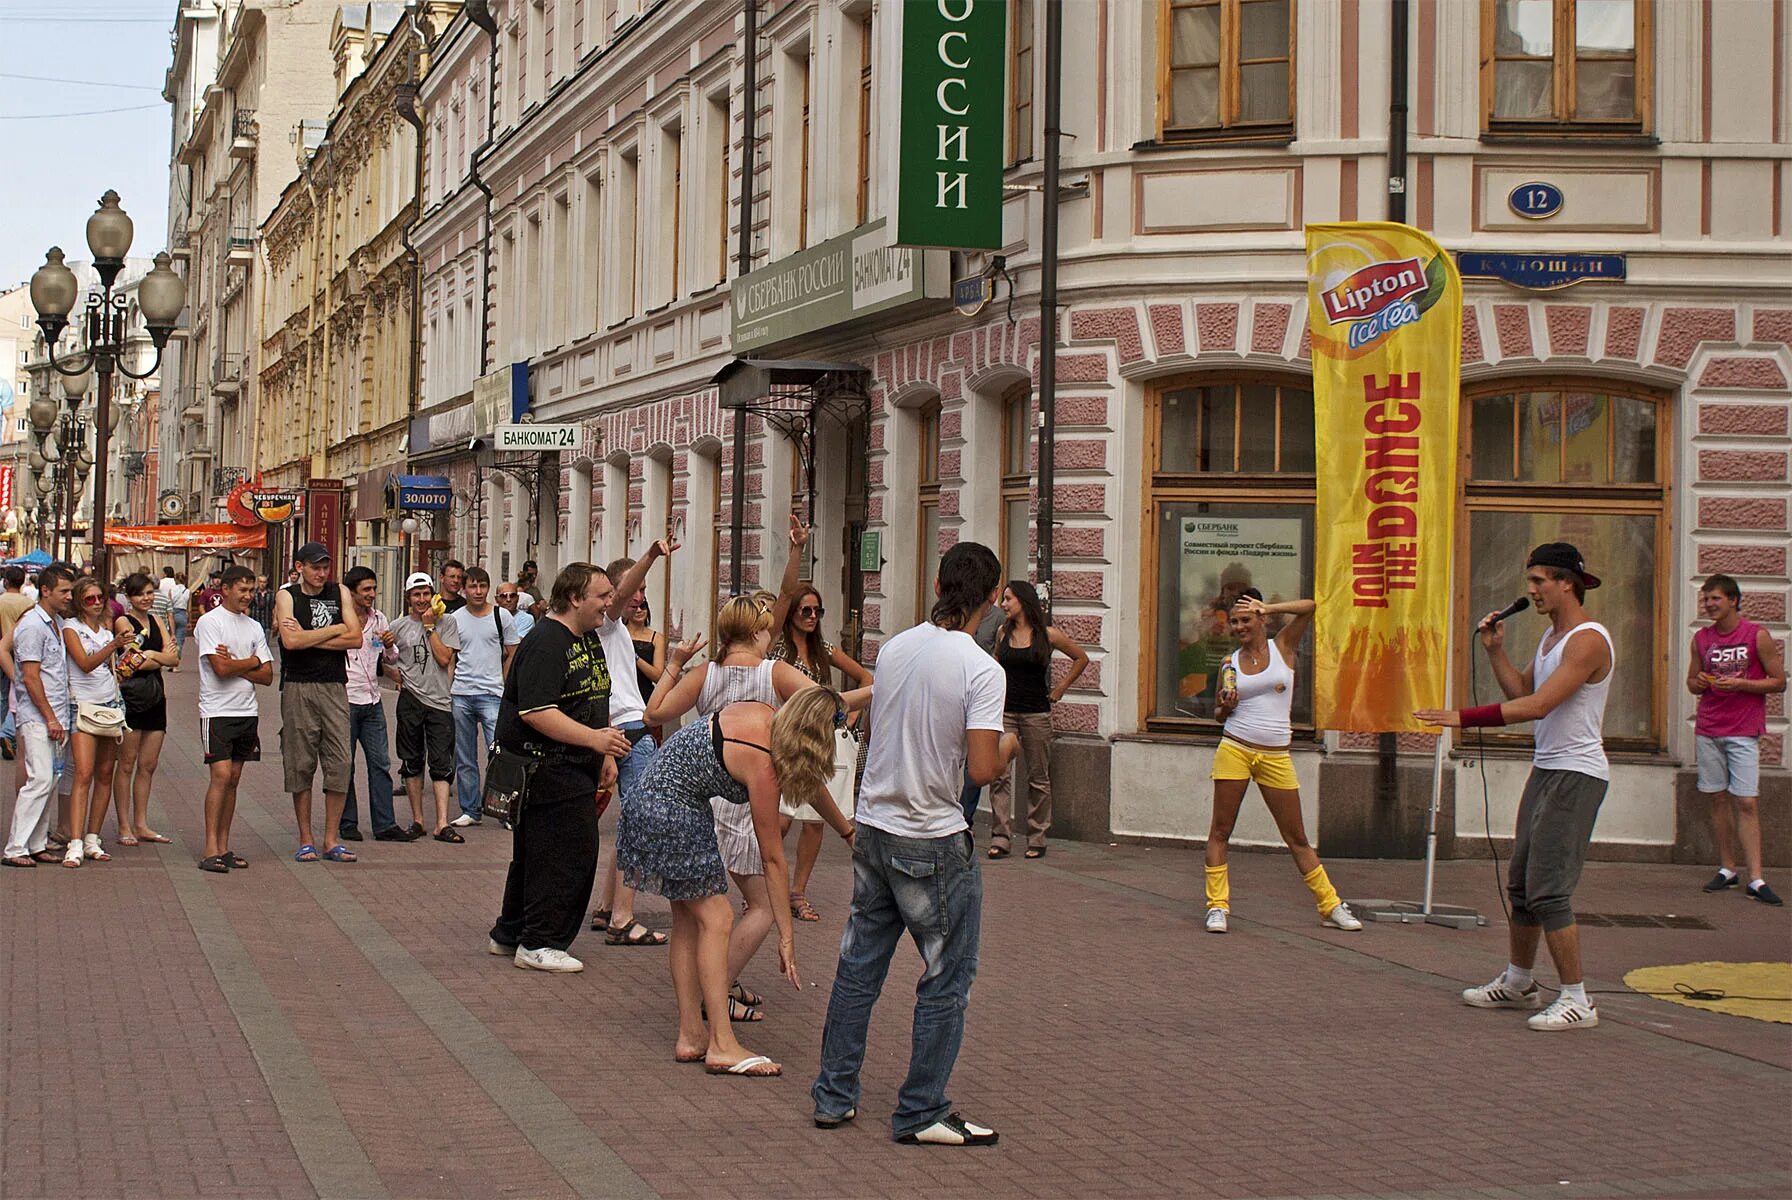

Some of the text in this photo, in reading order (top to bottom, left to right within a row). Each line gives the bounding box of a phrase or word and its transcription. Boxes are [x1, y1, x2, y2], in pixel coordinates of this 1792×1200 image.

[1526, 190, 1548, 209] 12
[748, 250, 844, 313] СБЕРБАНК РОССИИ
[897, 248, 911, 281] 24
[1480, 260, 1603, 273] КАЛОШИН
[1330, 269, 1417, 313] Lipton
[1350, 301, 1420, 348] Ice Tea
[503, 428, 575, 446] БАНКОМАТ 24
[1363, 372, 1421, 540] DANCE
[404, 493, 447, 504] ЗОЛОТО
[1197, 523, 1239, 531] СБЕРБАНК
[1352, 543, 1388, 608] JOIN
[1385, 543, 1417, 594] THE
